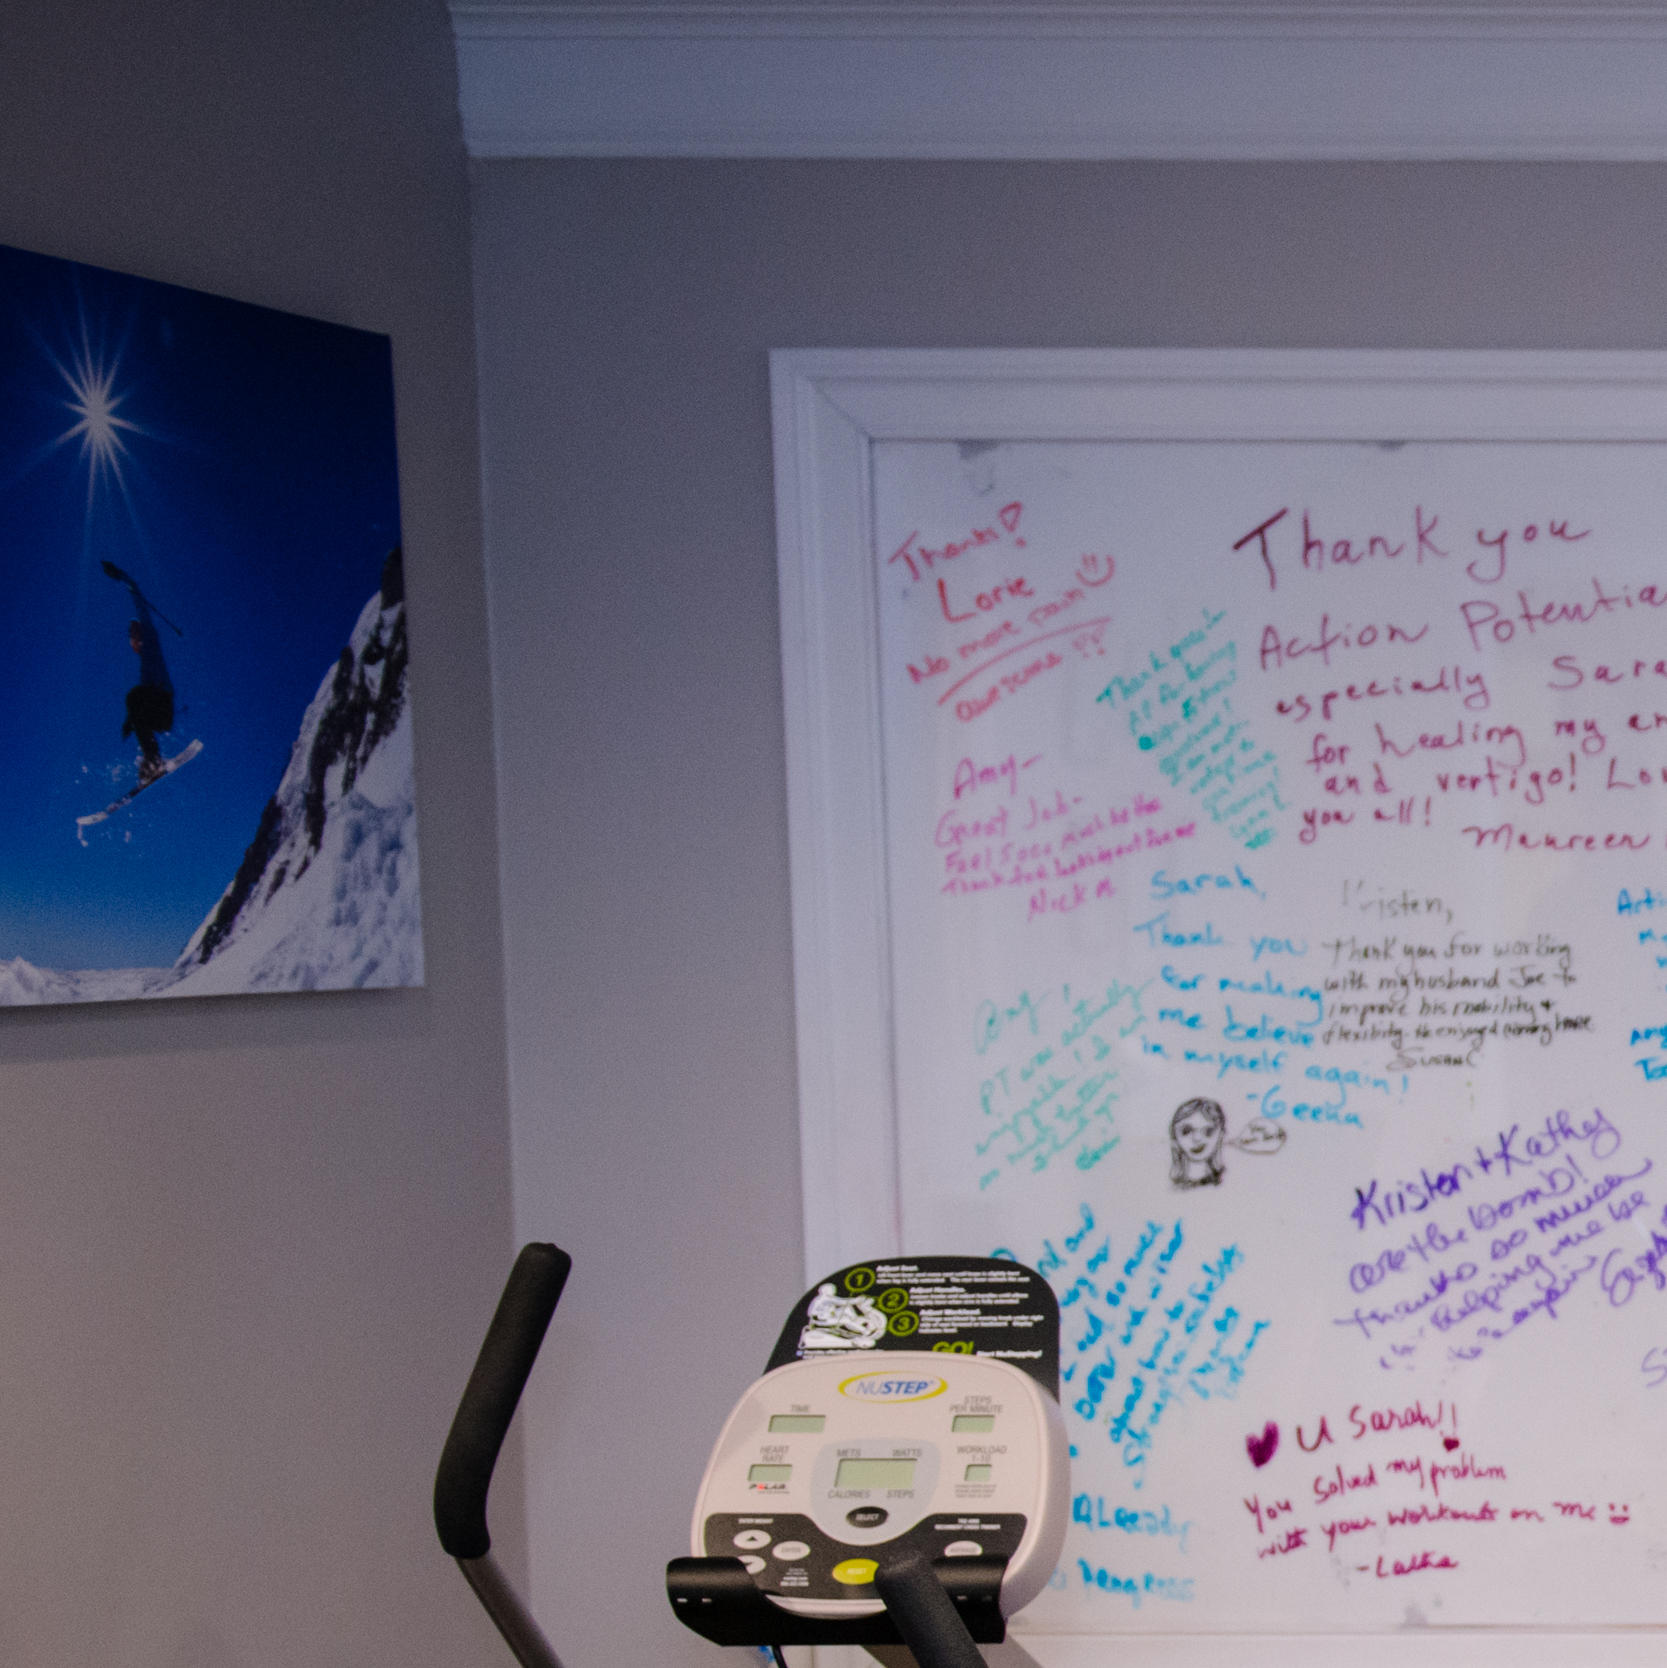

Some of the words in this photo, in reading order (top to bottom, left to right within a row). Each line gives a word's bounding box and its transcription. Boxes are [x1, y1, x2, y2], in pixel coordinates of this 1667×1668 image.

[1232, 504, 1450, 592] Thank
[1465, 518, 1592, 584] you
[1259, 614, 1429, 671] Action
[1306, 731, 1350, 773] for
[1324, 761, 1395, 797] and
[1298, 806, 1357, 846] you
[1373, 796, 1434, 829] all!
[1462, 821, 1652, 852] Maureen
[1249, 936, 1309, 962] you
[1296, 1415, 1334, 1452] U
[1243, 1495, 1293, 1534] You
